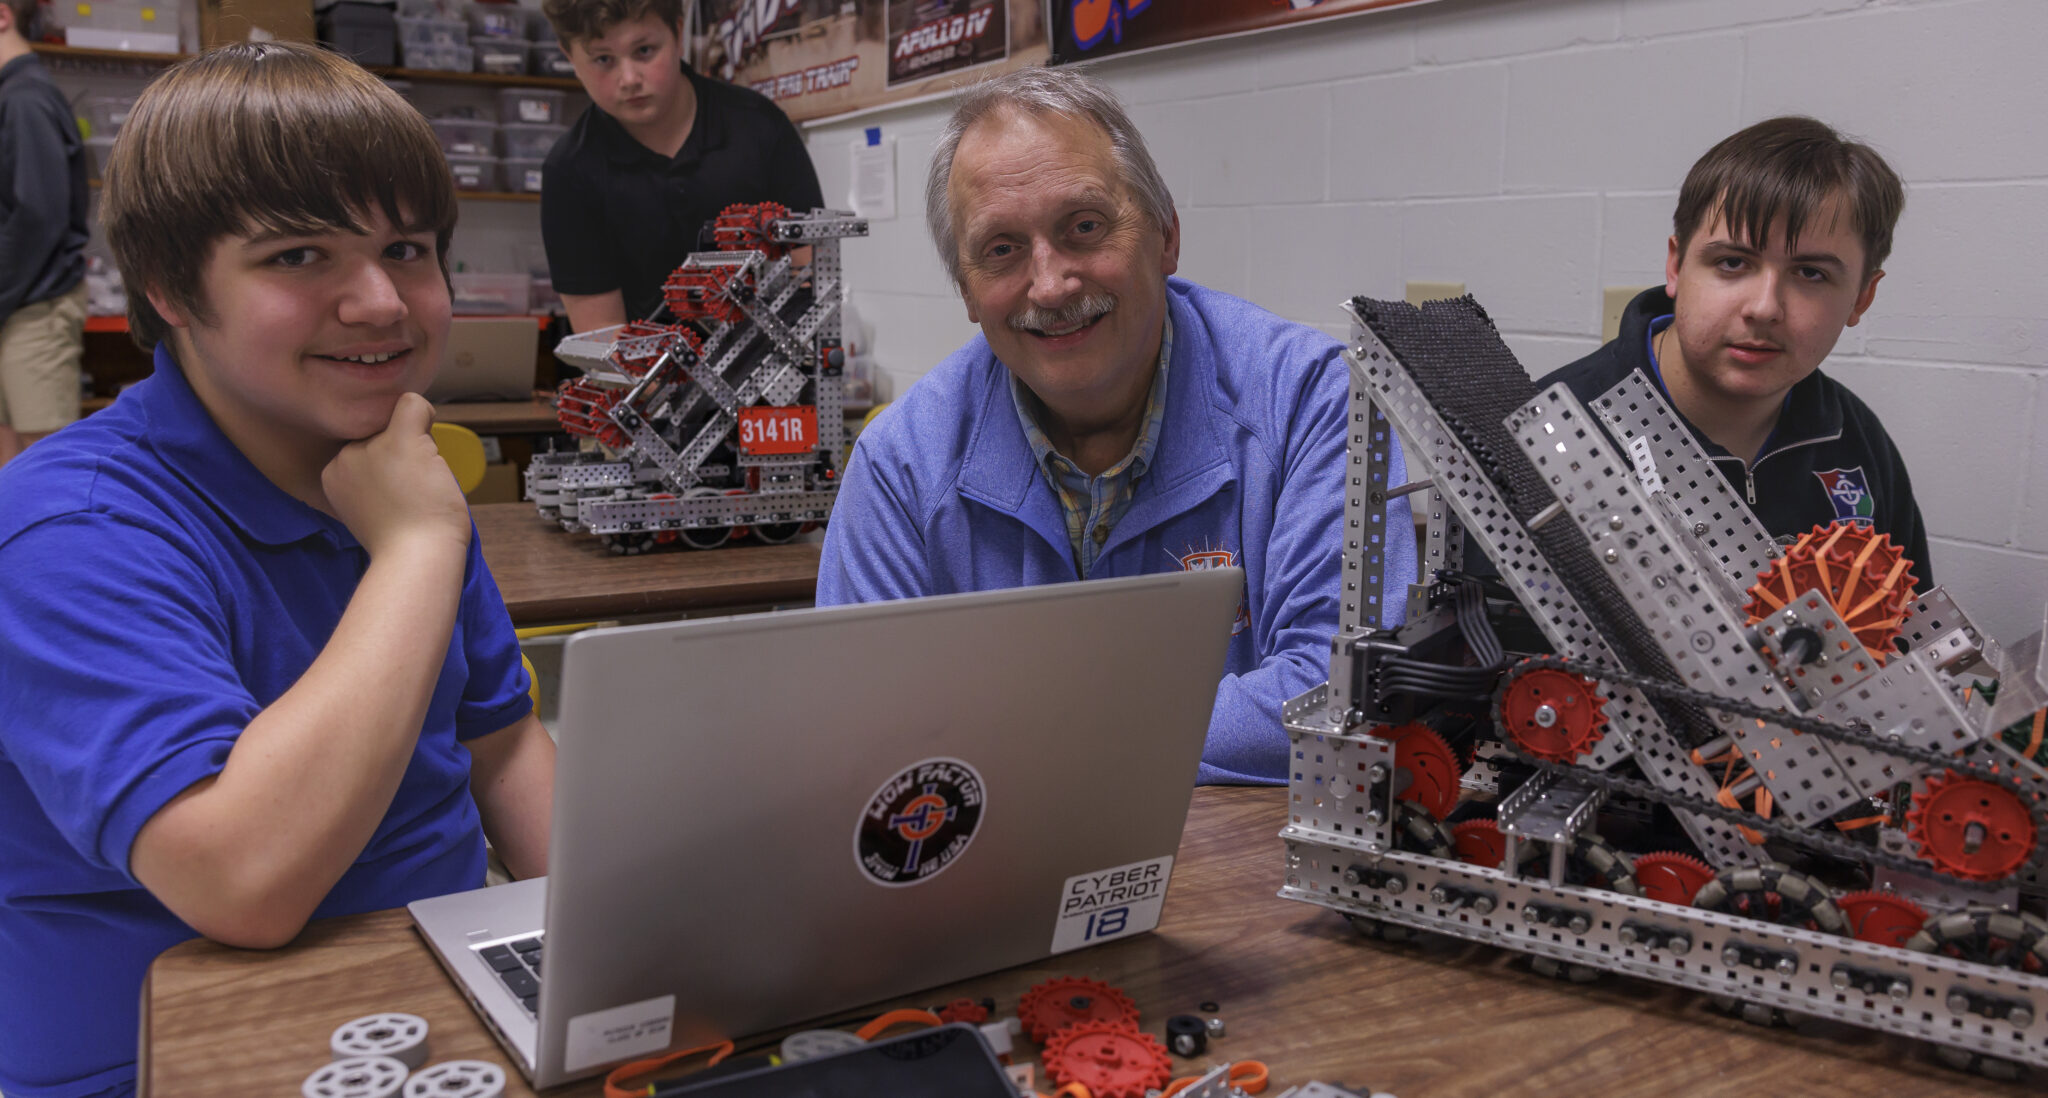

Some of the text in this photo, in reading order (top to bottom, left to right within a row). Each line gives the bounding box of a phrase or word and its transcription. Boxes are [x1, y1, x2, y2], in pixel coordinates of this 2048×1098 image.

[895, 7, 992, 58] APOLLO IV
[742, 418, 803, 442] 3141R
[869, 772, 914, 820] WOW
[1064, 878, 1163, 913] PATRIOT
[1072, 863, 1161, 895] CYBER
[1084, 906, 1129, 941] 18
